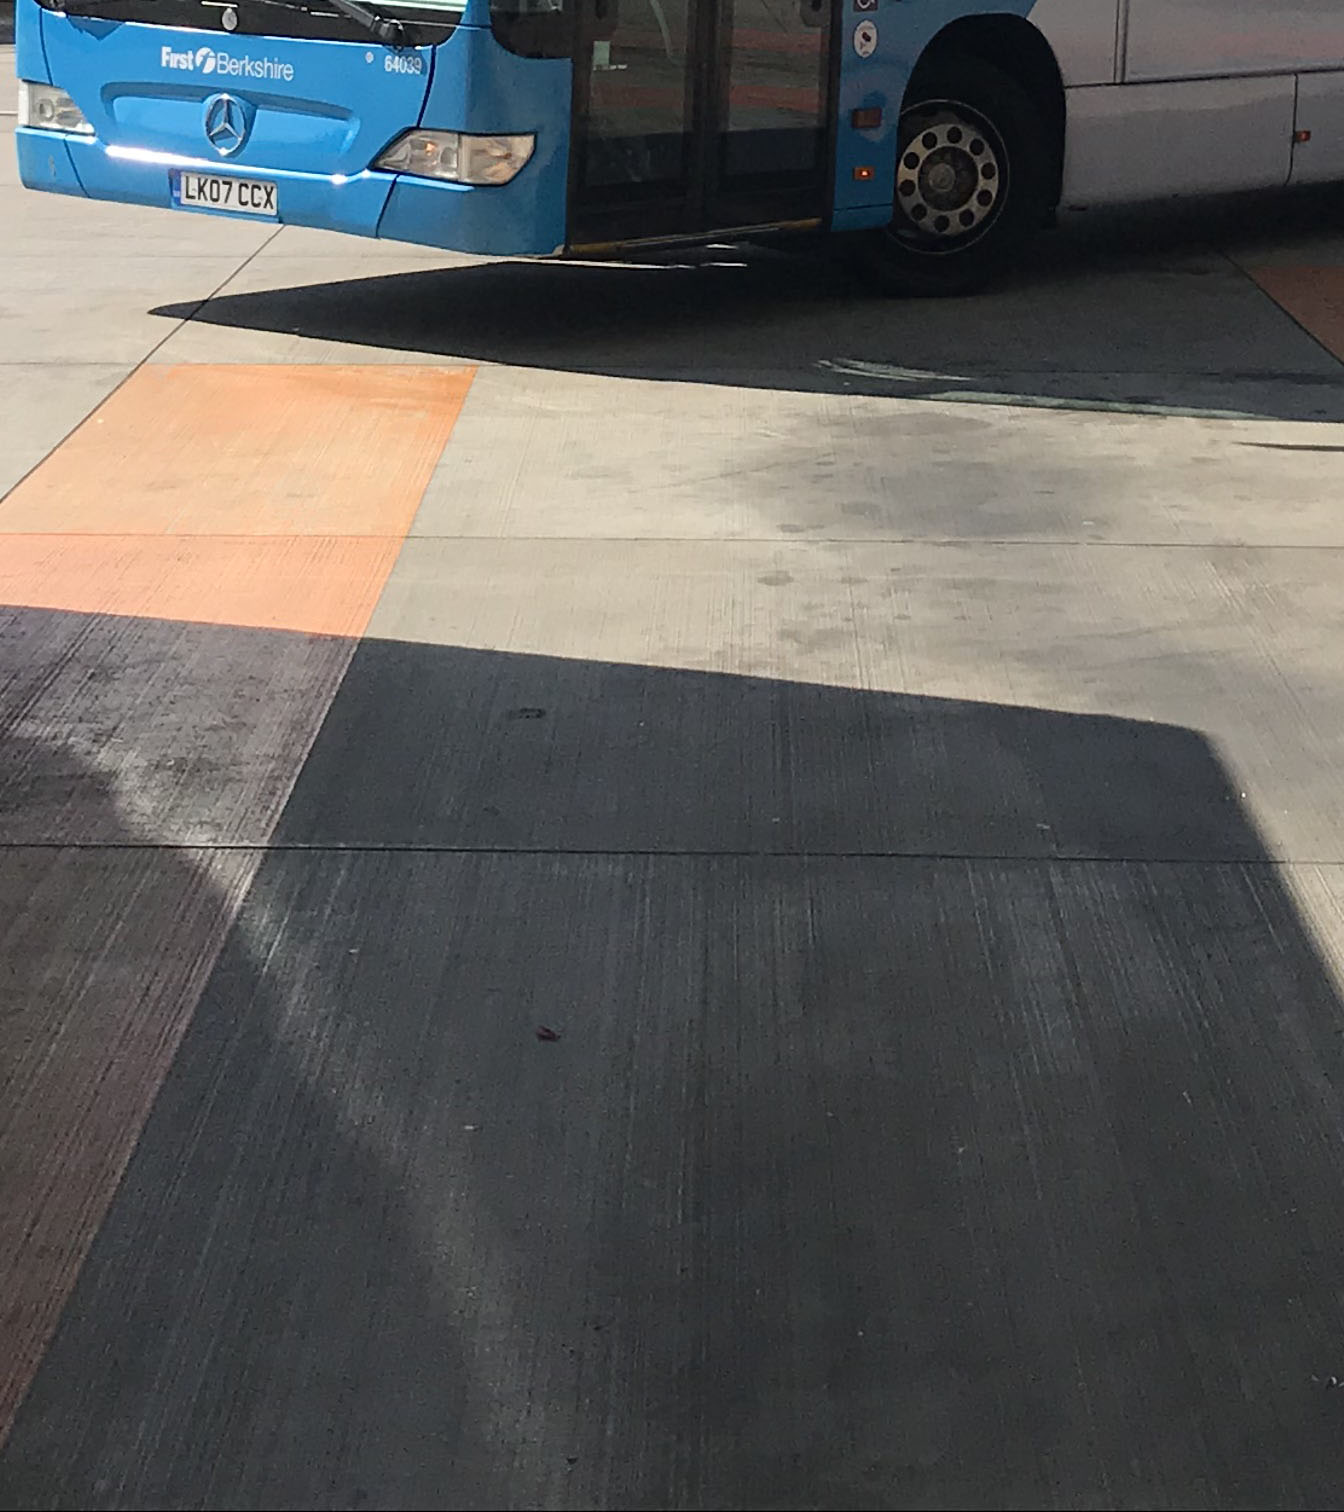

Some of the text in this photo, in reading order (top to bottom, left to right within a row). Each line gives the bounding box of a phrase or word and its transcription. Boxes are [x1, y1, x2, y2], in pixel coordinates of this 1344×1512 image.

[161, 45, 422, 81] First Berkshire 64039
[185, 175, 274, 210] LK07 CCX
